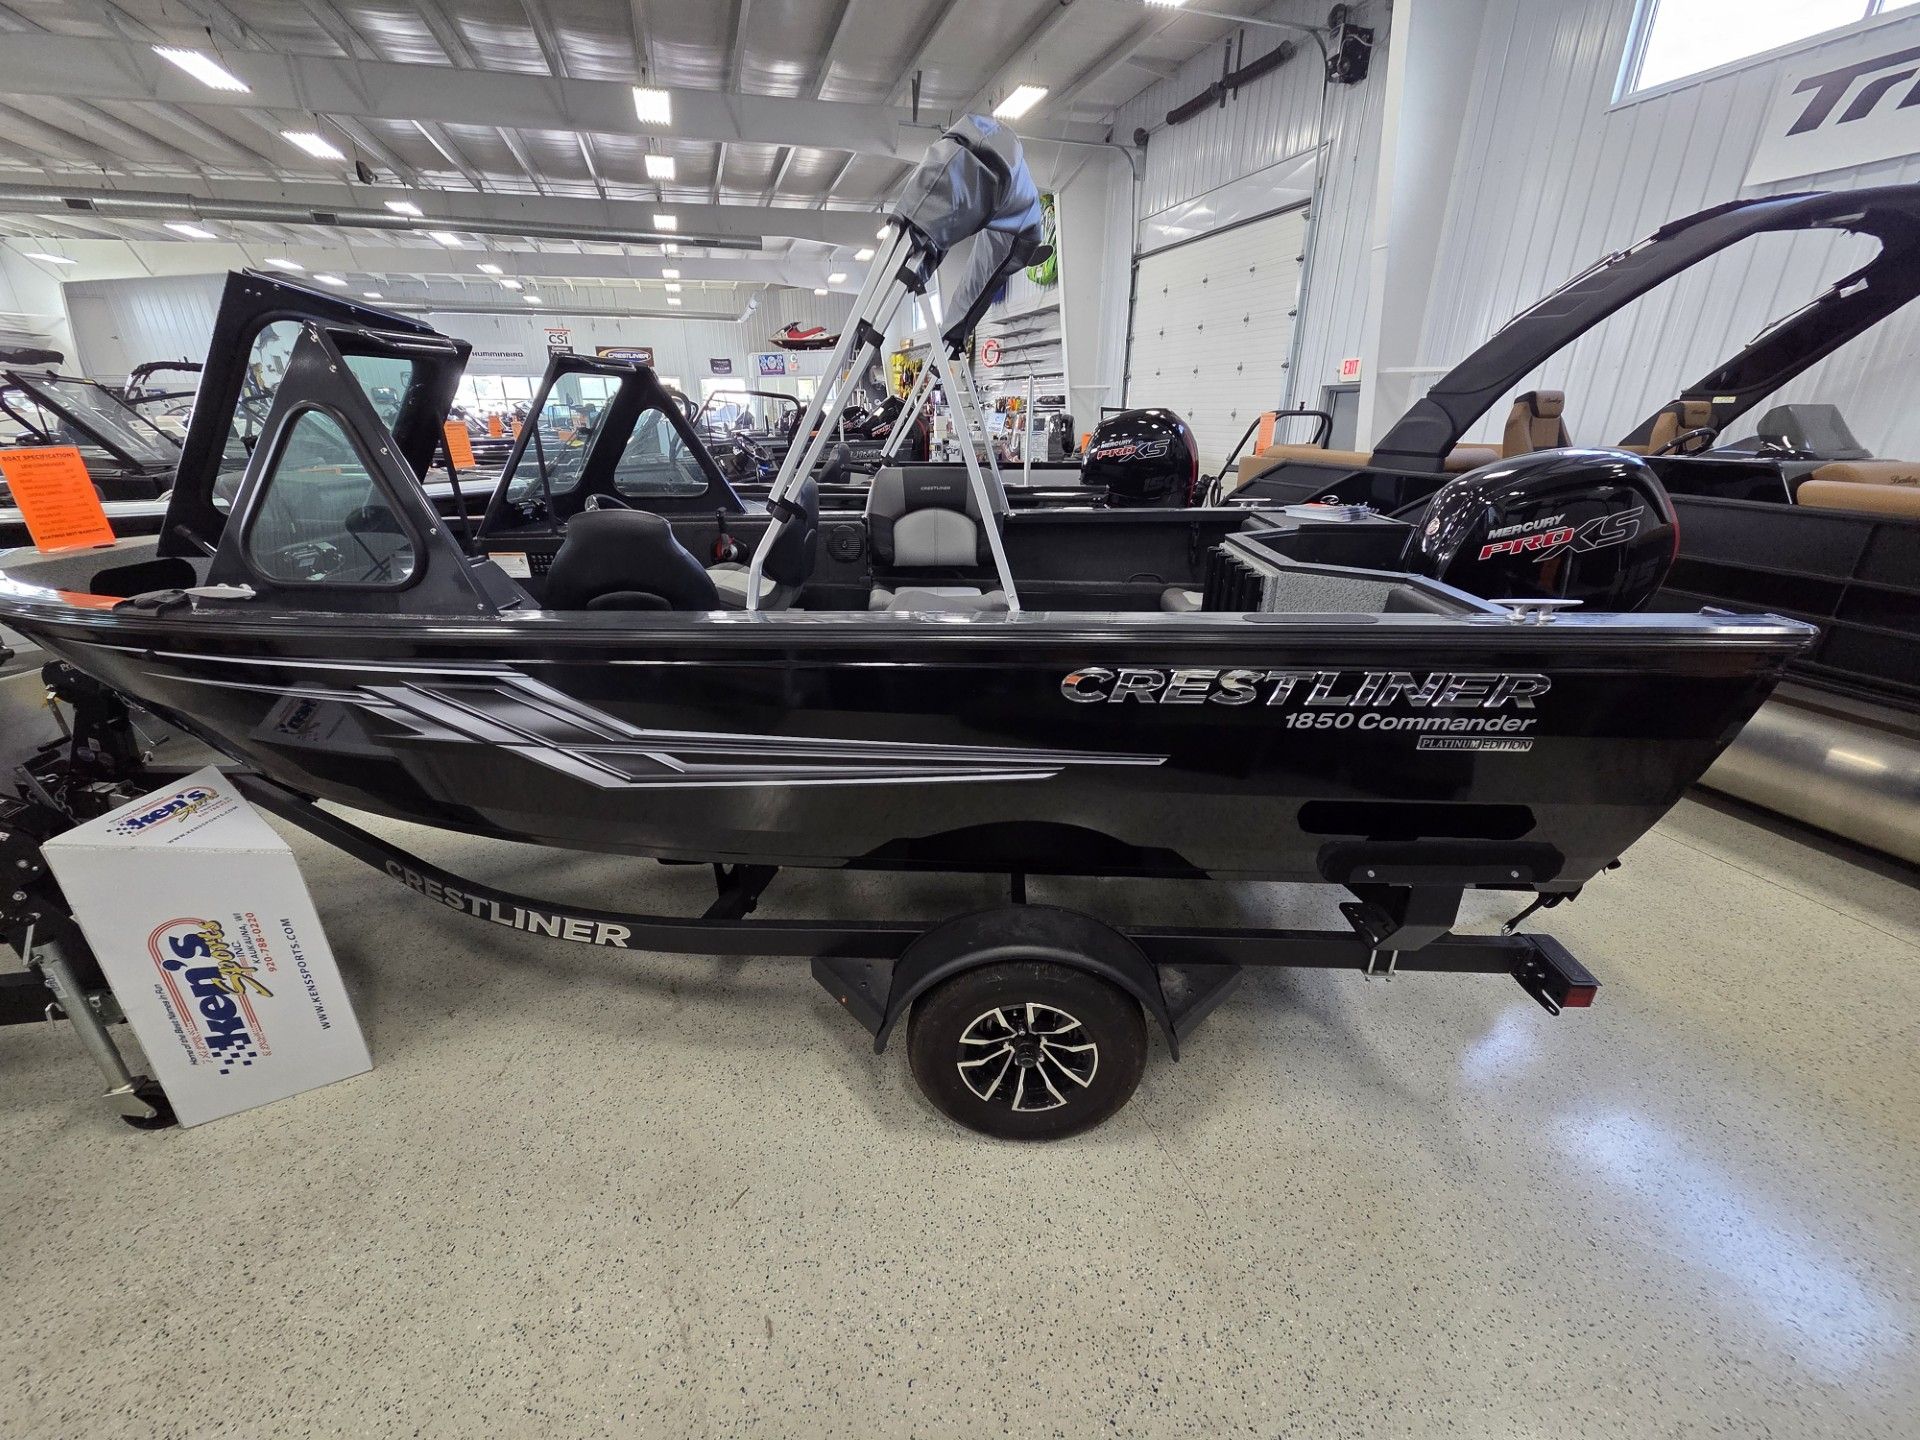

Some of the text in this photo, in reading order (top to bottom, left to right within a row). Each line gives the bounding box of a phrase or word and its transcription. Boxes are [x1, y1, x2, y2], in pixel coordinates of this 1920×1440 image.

[1343, 359, 1359, 375] EXIT
[1100, 438, 1133, 449] MERCURY
[1487, 513, 1566, 540] MERCURY
[1060, 667, 1551, 709] CRESTLINER
[1285, 712, 1537, 732] 1850 Commander
[1421, 738, 1532, 751] PLATINUM EDITION
[385, 860, 632, 948] CRESTLINER
[232, 912, 243, 922] WI
[244, 911, 278, 972] 920-788-0220
[279, 917, 332, 1031] WWW.KENSSPORTS.COM
